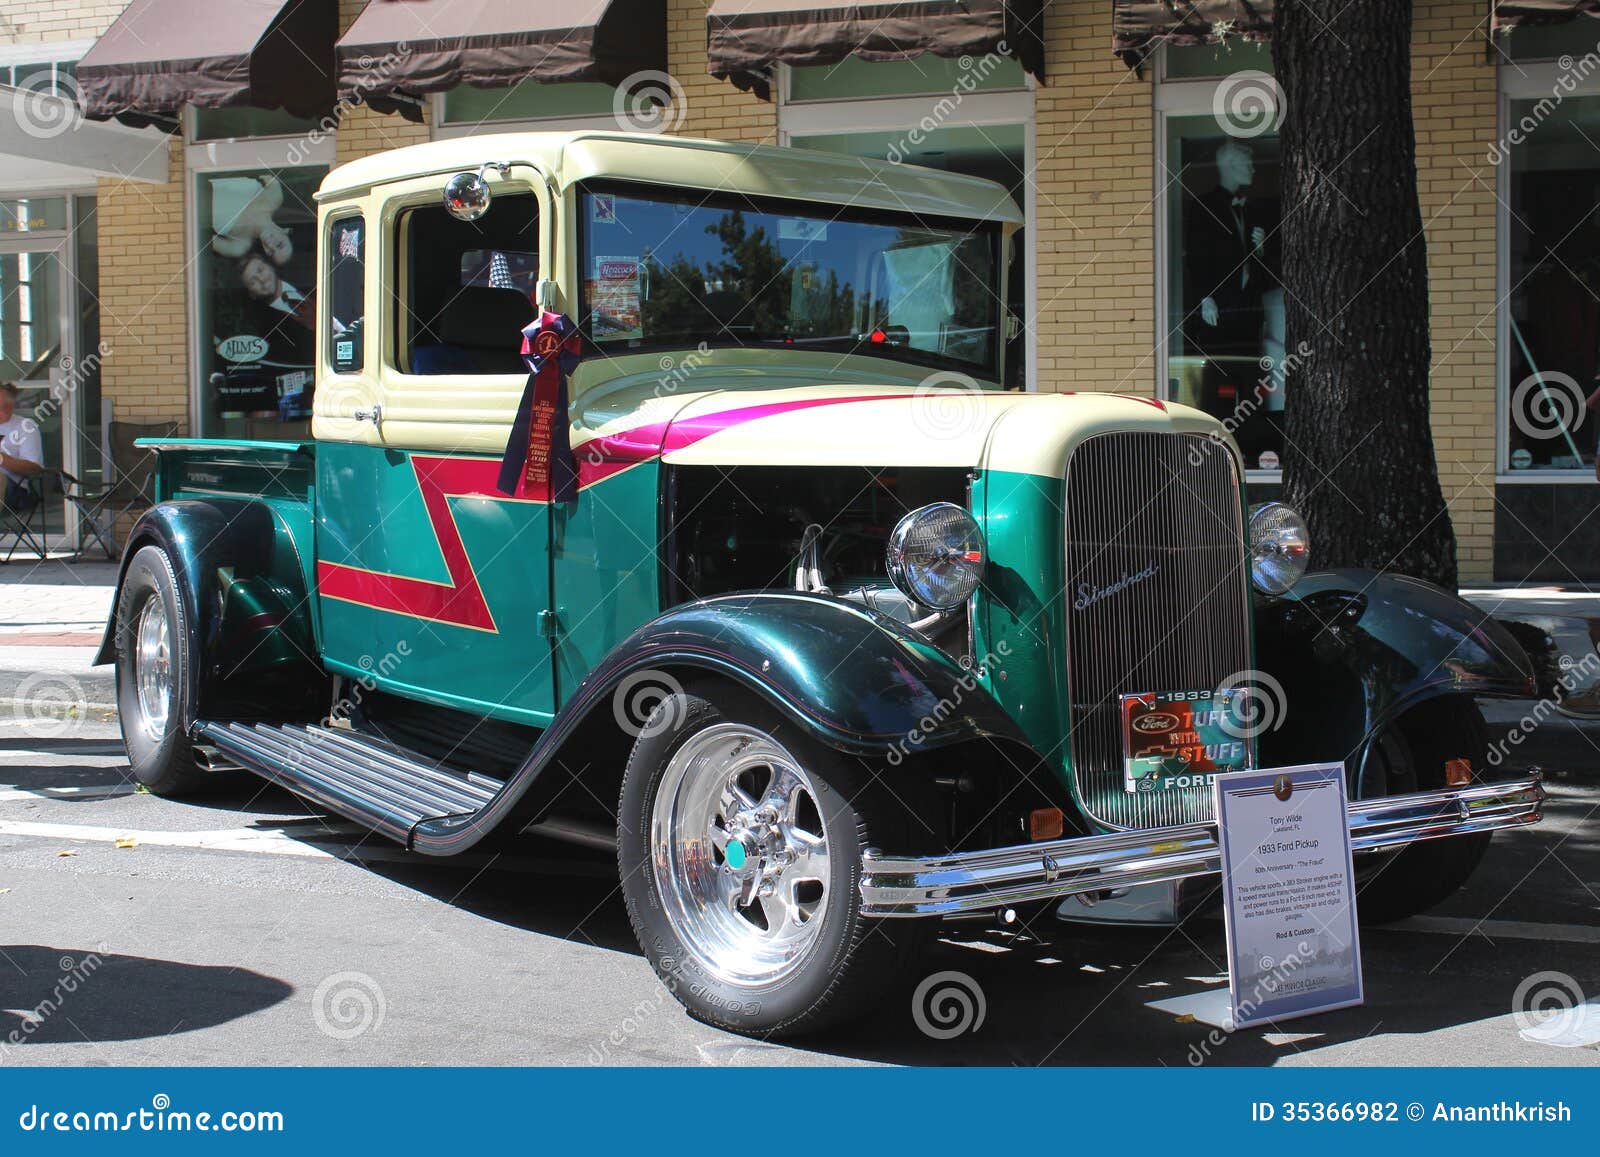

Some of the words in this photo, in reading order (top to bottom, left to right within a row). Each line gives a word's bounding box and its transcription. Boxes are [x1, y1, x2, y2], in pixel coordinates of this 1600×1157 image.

[1140, 716, 1169, 730] Ford
[1182, 709, 1233, 728] TUFF
[1168, 731, 1200, 744] WITH
[1178, 742, 1243, 763] STUFF
[1270, 816, 1284, 826] Tony
[1285, 814, 1302, 824] Wilde
[1258, 843, 1275, 855] 1933
[1278, 841, 1293, 852] Ford
[1295, 839, 1319, 849] Pickup
[1266, 863, 1293, 872] Anniversary
[1276, 931, 1287, 940] Rod
[1294, 928, 1315, 937] Custom
